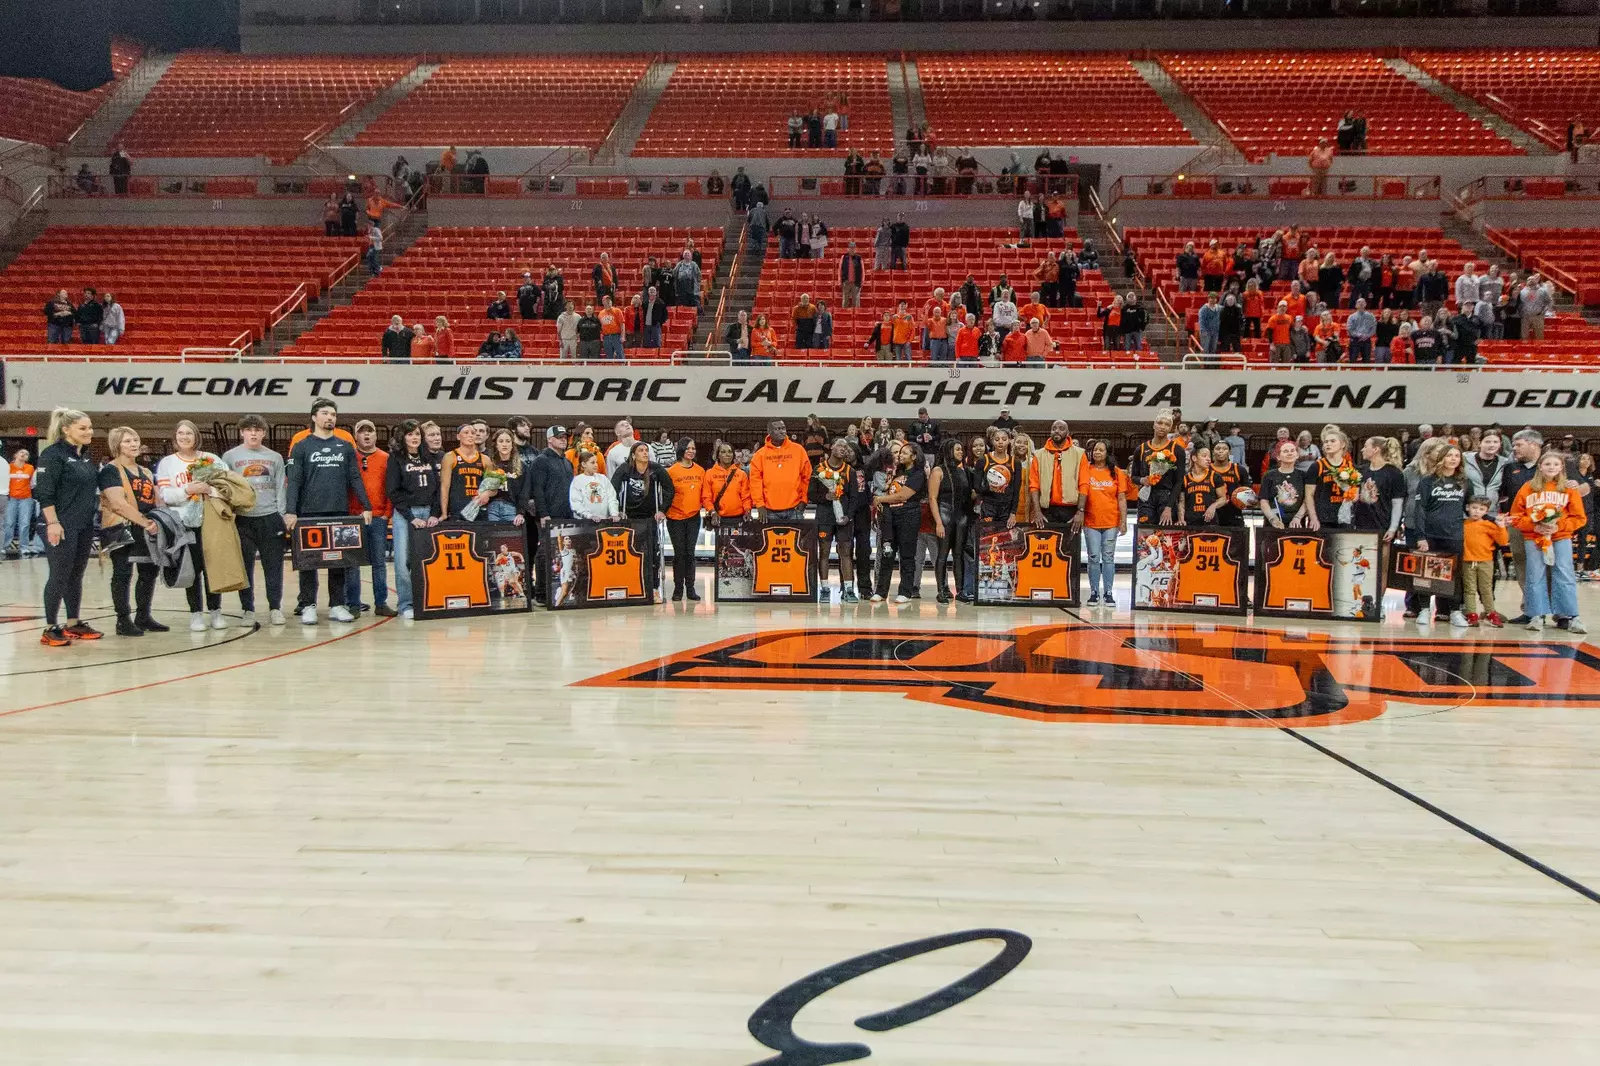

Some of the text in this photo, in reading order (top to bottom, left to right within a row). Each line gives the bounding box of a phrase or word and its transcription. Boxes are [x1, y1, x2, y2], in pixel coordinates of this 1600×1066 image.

[571, 200, 583, 210] 212
[460, 366, 472, 376] 107
[948, 368, 961, 379] 108
[95, 377, 292, 397] WELCOME
[306, 377, 361, 397] TO
[426, 376, 687, 402] HISTORIC
[1209, 384, 1408, 409] ARENA
[310, 451, 345, 464] Cowgirls
[418, 474, 428, 487] 11
[464, 475, 478, 488] 11
[1195, 493, 1203, 504] 6
[1431, 486, 1465, 498] Cowgirls
[1525, 491, 1569, 508] OKLAHOMA
[307, 528, 323, 548] 0
[445, 552, 466, 571] 11
[605, 549, 627, 566] 30
[771, 547, 791, 563] 25
[1031, 552, 1053, 568] 20
[1195, 554, 1220, 572] 34
[1292, 557, 1306, 575] 4
[1402, 554, 1418, 573] 0
